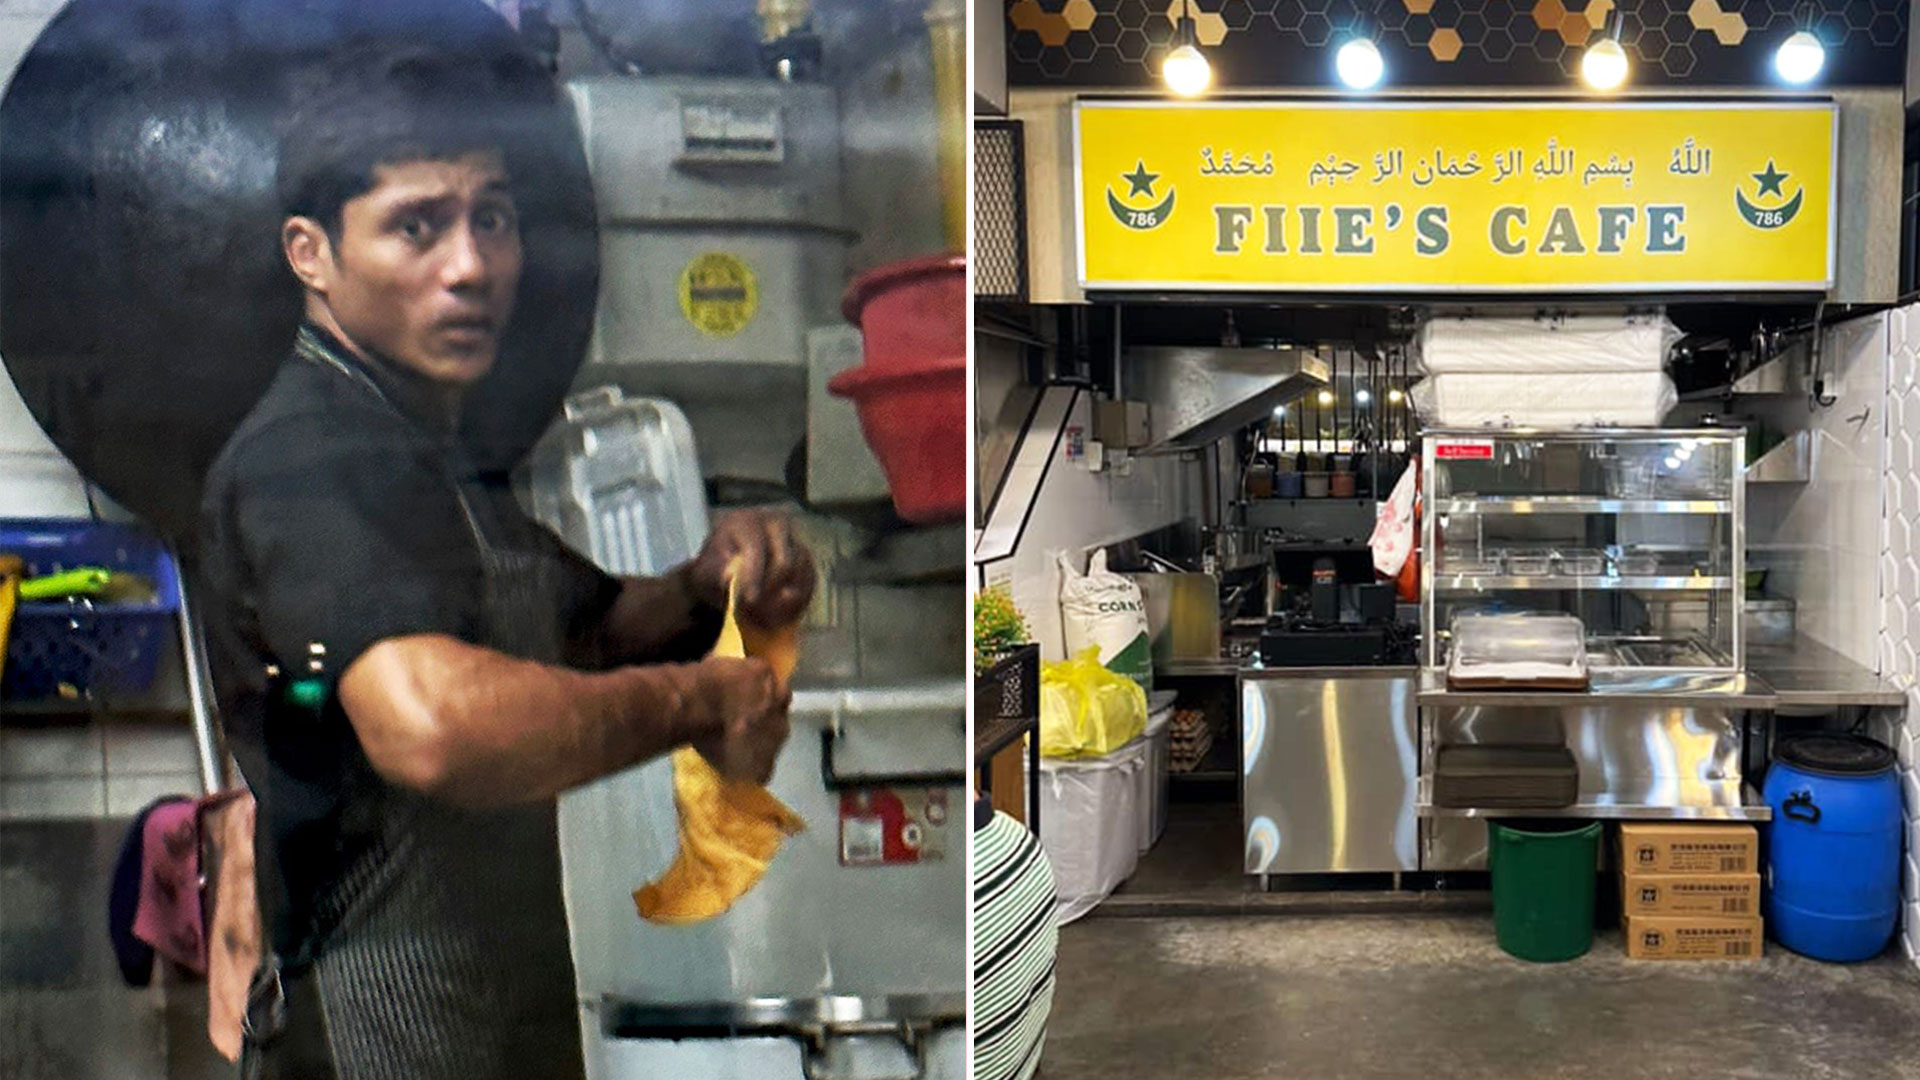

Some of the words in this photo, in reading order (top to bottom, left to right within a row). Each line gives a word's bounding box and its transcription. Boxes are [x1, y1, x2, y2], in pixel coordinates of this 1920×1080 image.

[1127, 211, 1157, 227] 786
[1755, 211, 1784, 226] 786
[1490, 206, 1686, 255] CAFE
